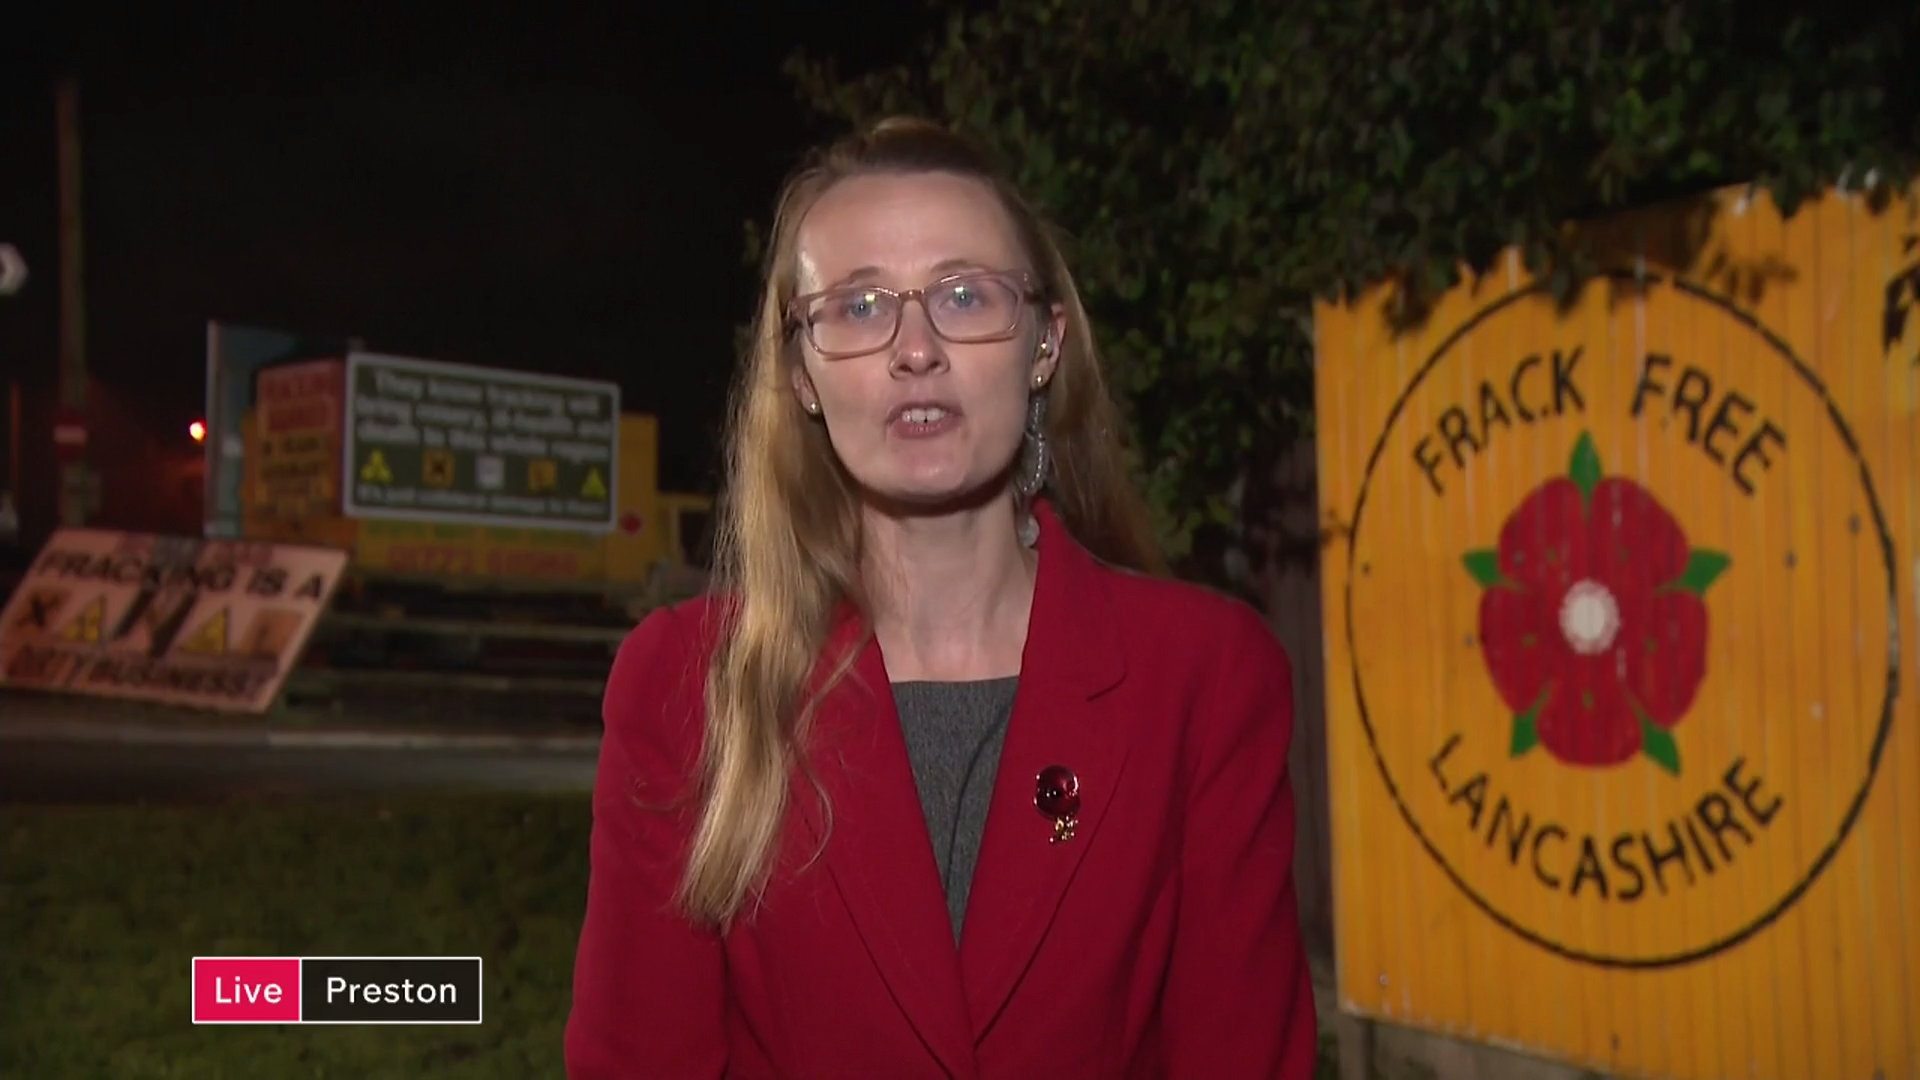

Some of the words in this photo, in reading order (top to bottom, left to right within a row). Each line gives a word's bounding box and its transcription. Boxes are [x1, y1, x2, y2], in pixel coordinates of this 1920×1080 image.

[375, 368, 425, 400] They
[1413, 345, 1586, 497] FRACK
[1631, 353, 1788, 497] FREE
[39, 551, 235, 591] FRACKING
[247, 568, 288, 596] IS
[294, 572, 323, 598] A
[1427, 733, 1784, 903] LANCASHIRE
